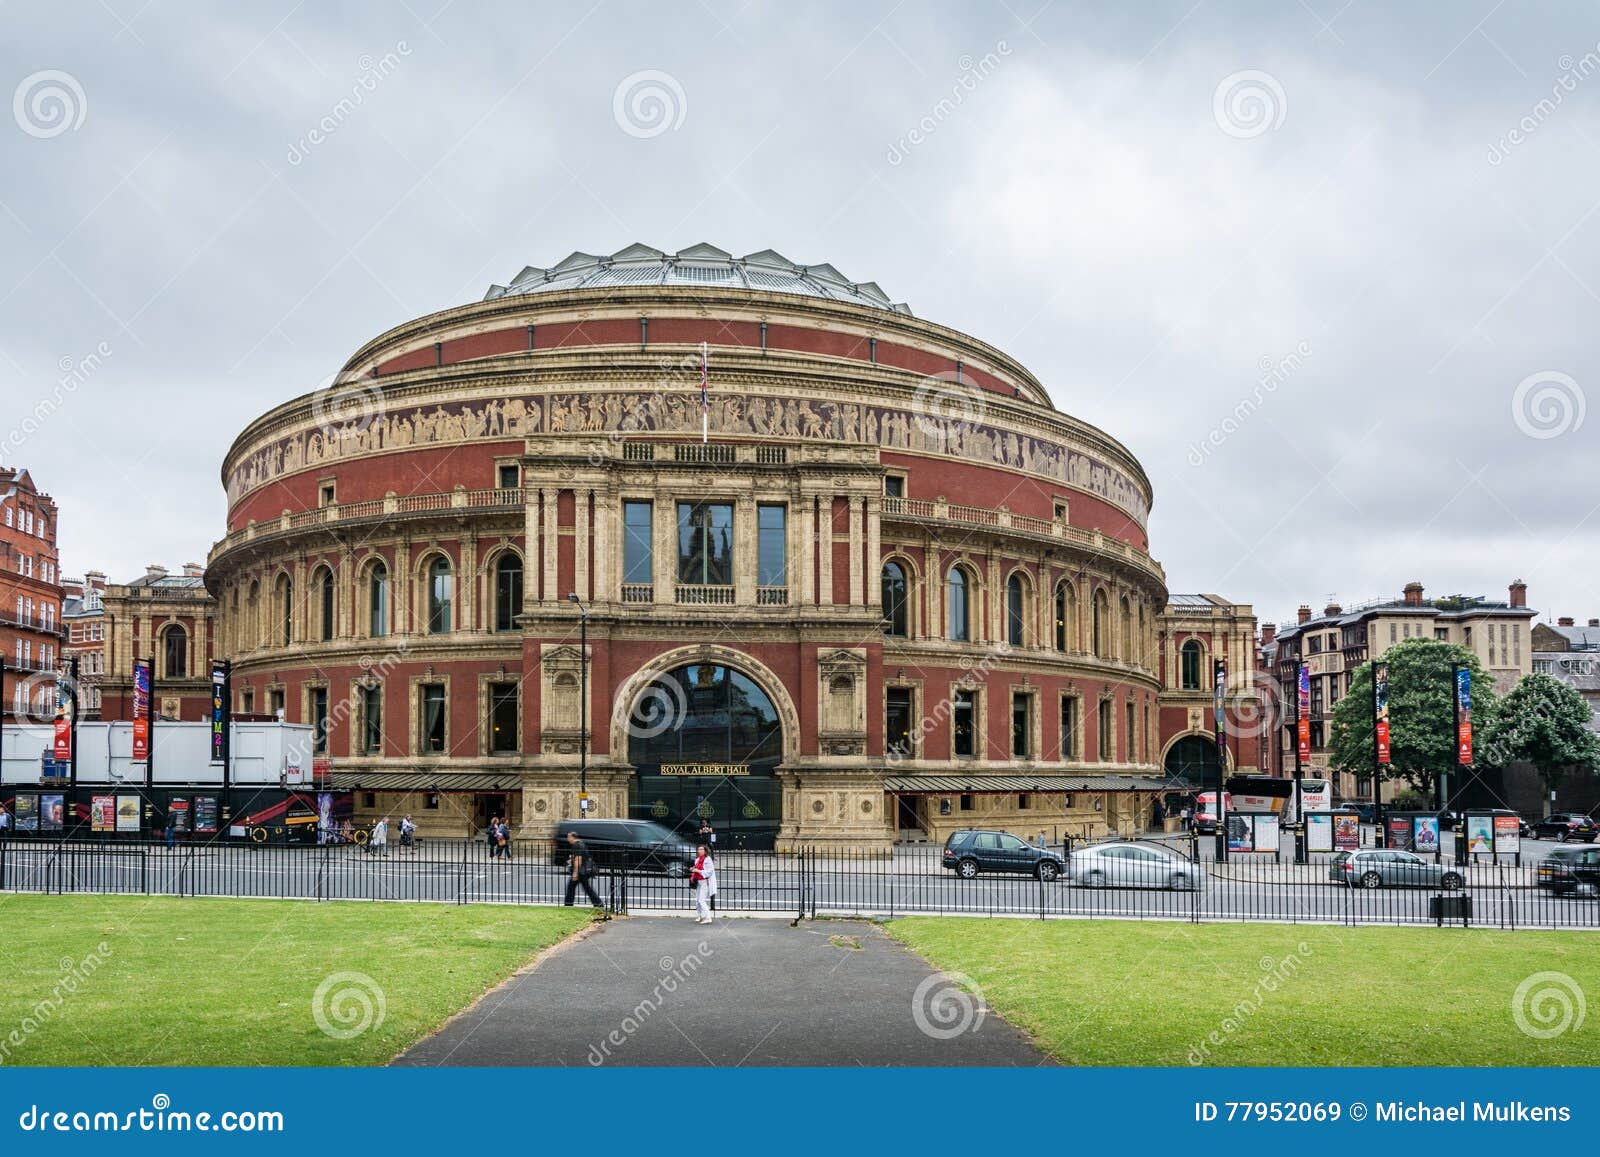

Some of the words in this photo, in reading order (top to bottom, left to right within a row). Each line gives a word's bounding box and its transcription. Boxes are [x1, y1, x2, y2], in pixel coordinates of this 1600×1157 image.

[661, 765, 690, 775] ROYAL
[691, 765, 725, 775] ALBERT
[726, 765, 750, 775] HALL
